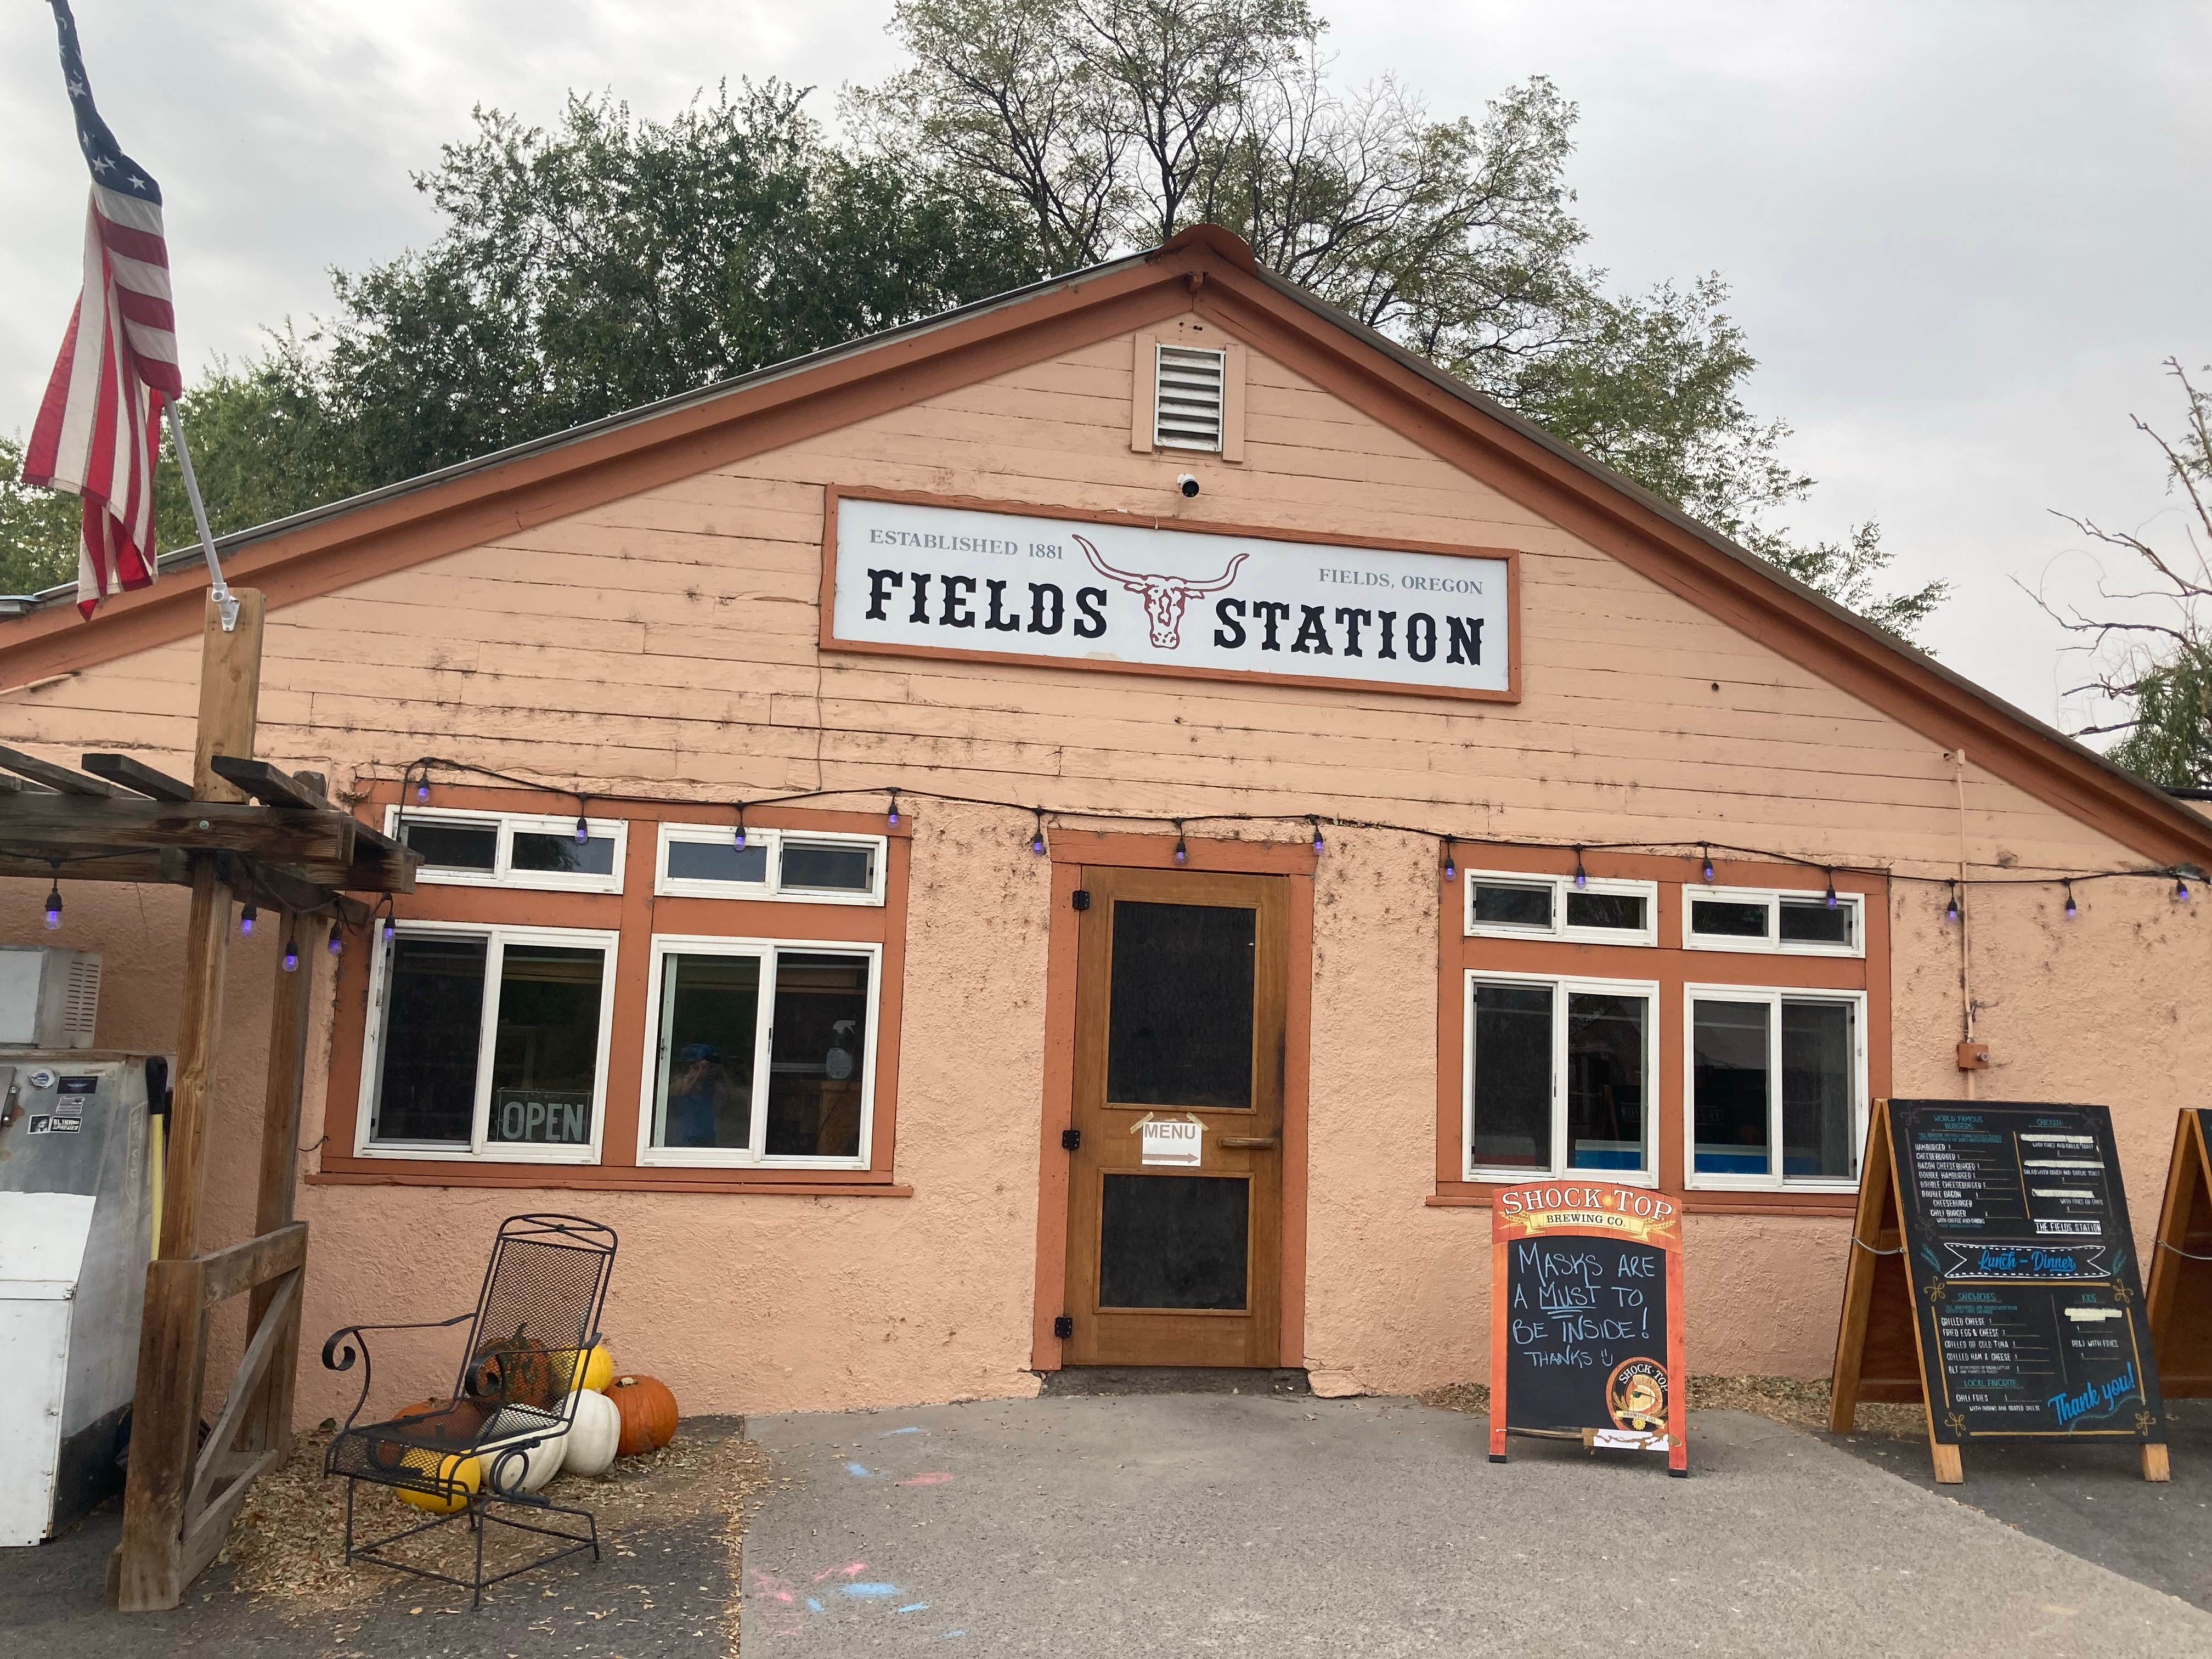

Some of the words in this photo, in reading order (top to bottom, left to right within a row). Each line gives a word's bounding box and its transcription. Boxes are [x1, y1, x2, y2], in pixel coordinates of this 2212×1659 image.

[870, 529, 1018, 555] ESTABLISHED
[1028, 543, 1063, 560] 1881
[1319, 568, 1394, 589] FIELDS,
[1402, 575, 1483, 595] OREGON
[866, 568, 1107, 639] FIELDS
[1214, 597, 1485, 666] STATION
[503, 1101, 584, 1141] OPEN
[1957, 1115, 1983, 1123] FAMOUS
[1144, 1124, 1195, 1139] MENU
[1937, 1162, 1976, 1171] CHEESEBURGER
[1920, 1181, 1940, 1189] DOUBLE
[1942, 1181, 1982, 1189] CHEESEBURGER
[1502, 1187, 1603, 1215] SHOCK
[1613, 1189, 1672, 1221] TOP
[1933, 1199, 1973, 1207] CHEESEBURGER
[1546, 1214, 1604, 1223] BREWING
[2035, 1222, 2049, 1231] THE
[2050, 1223, 2072, 1232] FIELDS
[2075, 1223, 2101, 1232] STATION
[1519, 1242, 1603, 1287] MASKS
[1618, 1256, 1655, 1278] ARE
[1979, 1249, 2017, 1271] Lunch
[2032, 1250, 2076, 1272] Dinner
[1514, 1284, 1528, 1309] A
[1539, 1282, 1601, 1308] MUST
[1611, 1287, 1644, 1307] TO
[1513, 1319, 1548, 1344] BE
[1941, 1317, 1963, 1326] GRILLED
[1943, 1329, 1959, 1337] FRIED
[1960, 1329, 1972, 1337] EGG
[1979, 1329, 1999, 1337] CHEESE
[1523, 1345, 1593, 1369] THANKS
[1947, 1353, 1969, 1361] GRILLED
[1971, 1353, 1982, 1361] HAM
[1619, 1364, 1652, 1385] SHOCK
[1949, 1365, 1958, 1374] BLT
[2047, 1382, 2100, 1425] Thank
[2102, 1362, 2136, 1411] you!
[1623, 1412, 1647, 1420] BREWING
